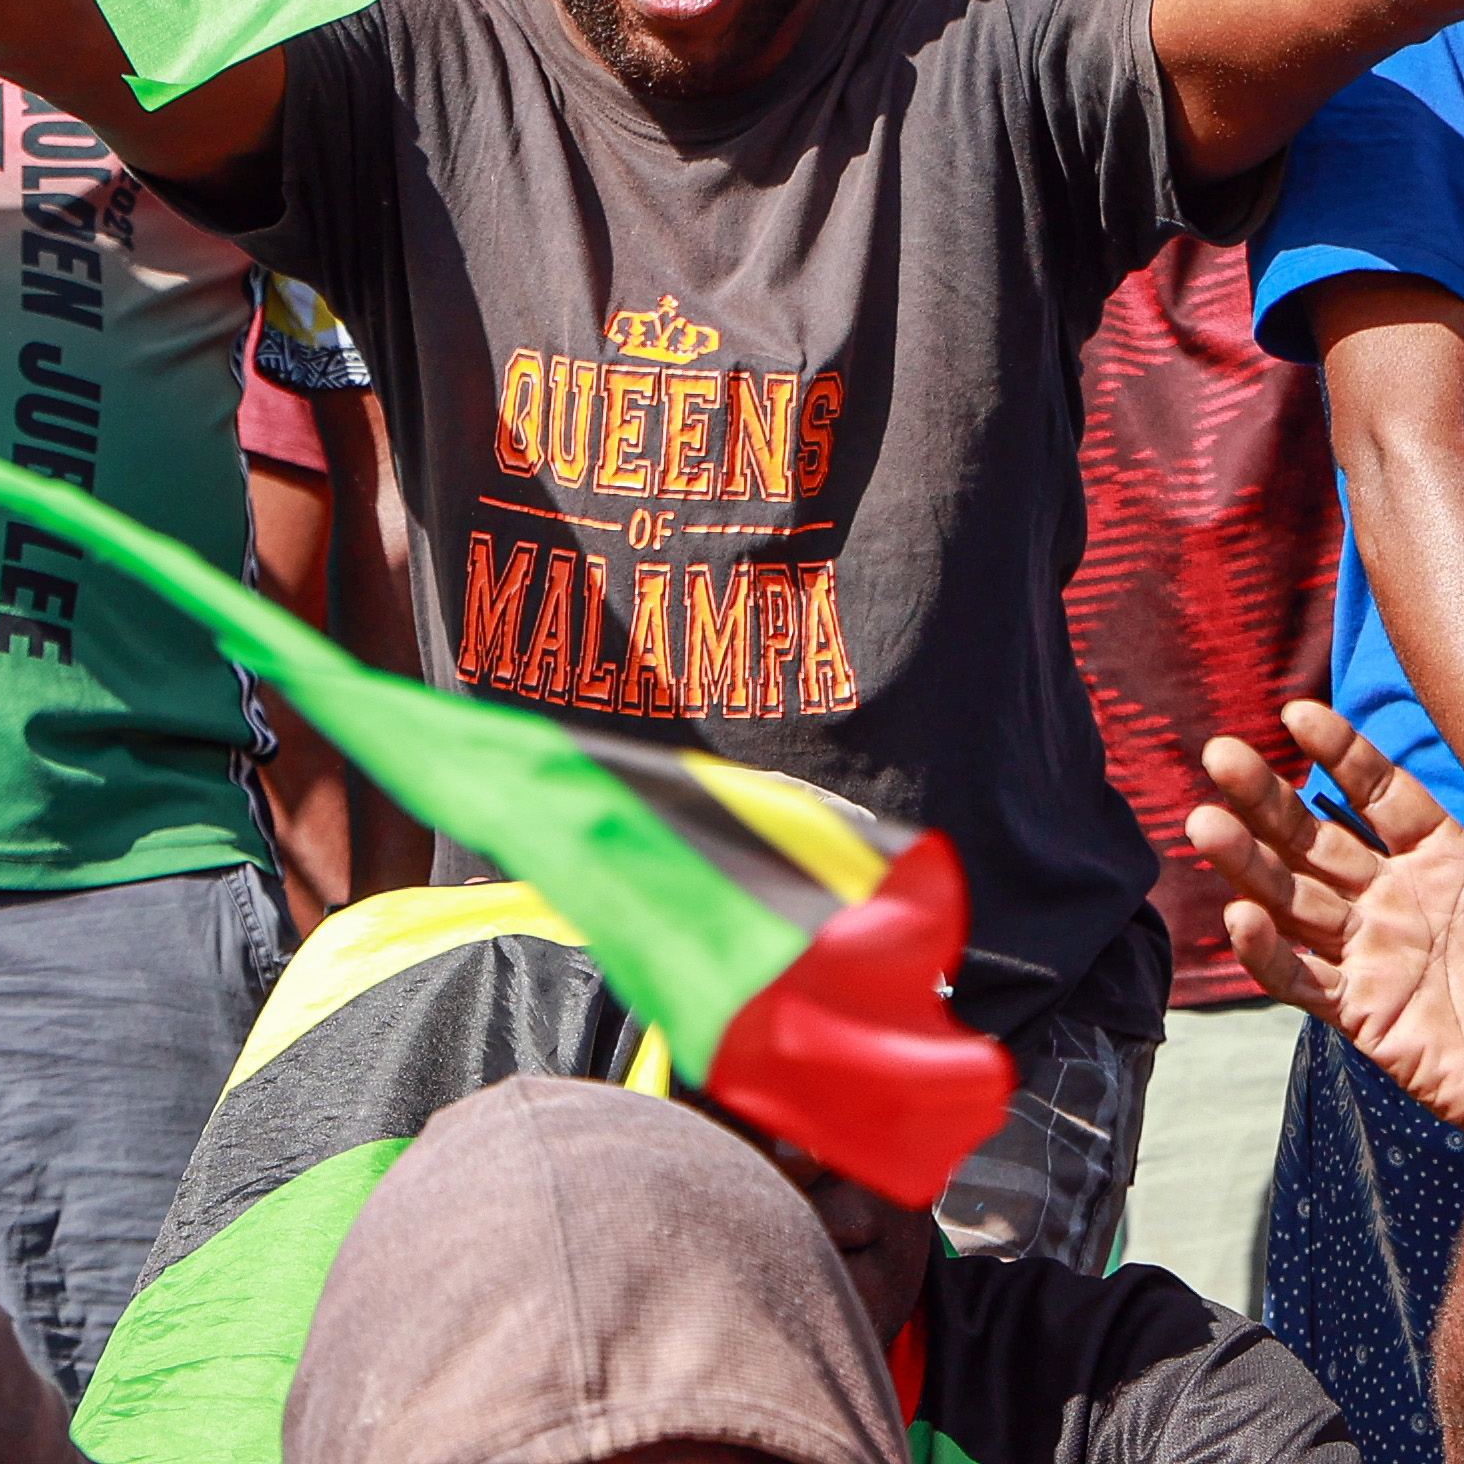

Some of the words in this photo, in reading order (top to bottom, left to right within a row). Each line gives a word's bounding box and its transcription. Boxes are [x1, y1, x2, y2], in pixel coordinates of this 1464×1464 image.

[492, 348, 845, 503] QUEENS
[628, 508, 675, 550] OF
[455, 531, 859, 719] MALAMPA
